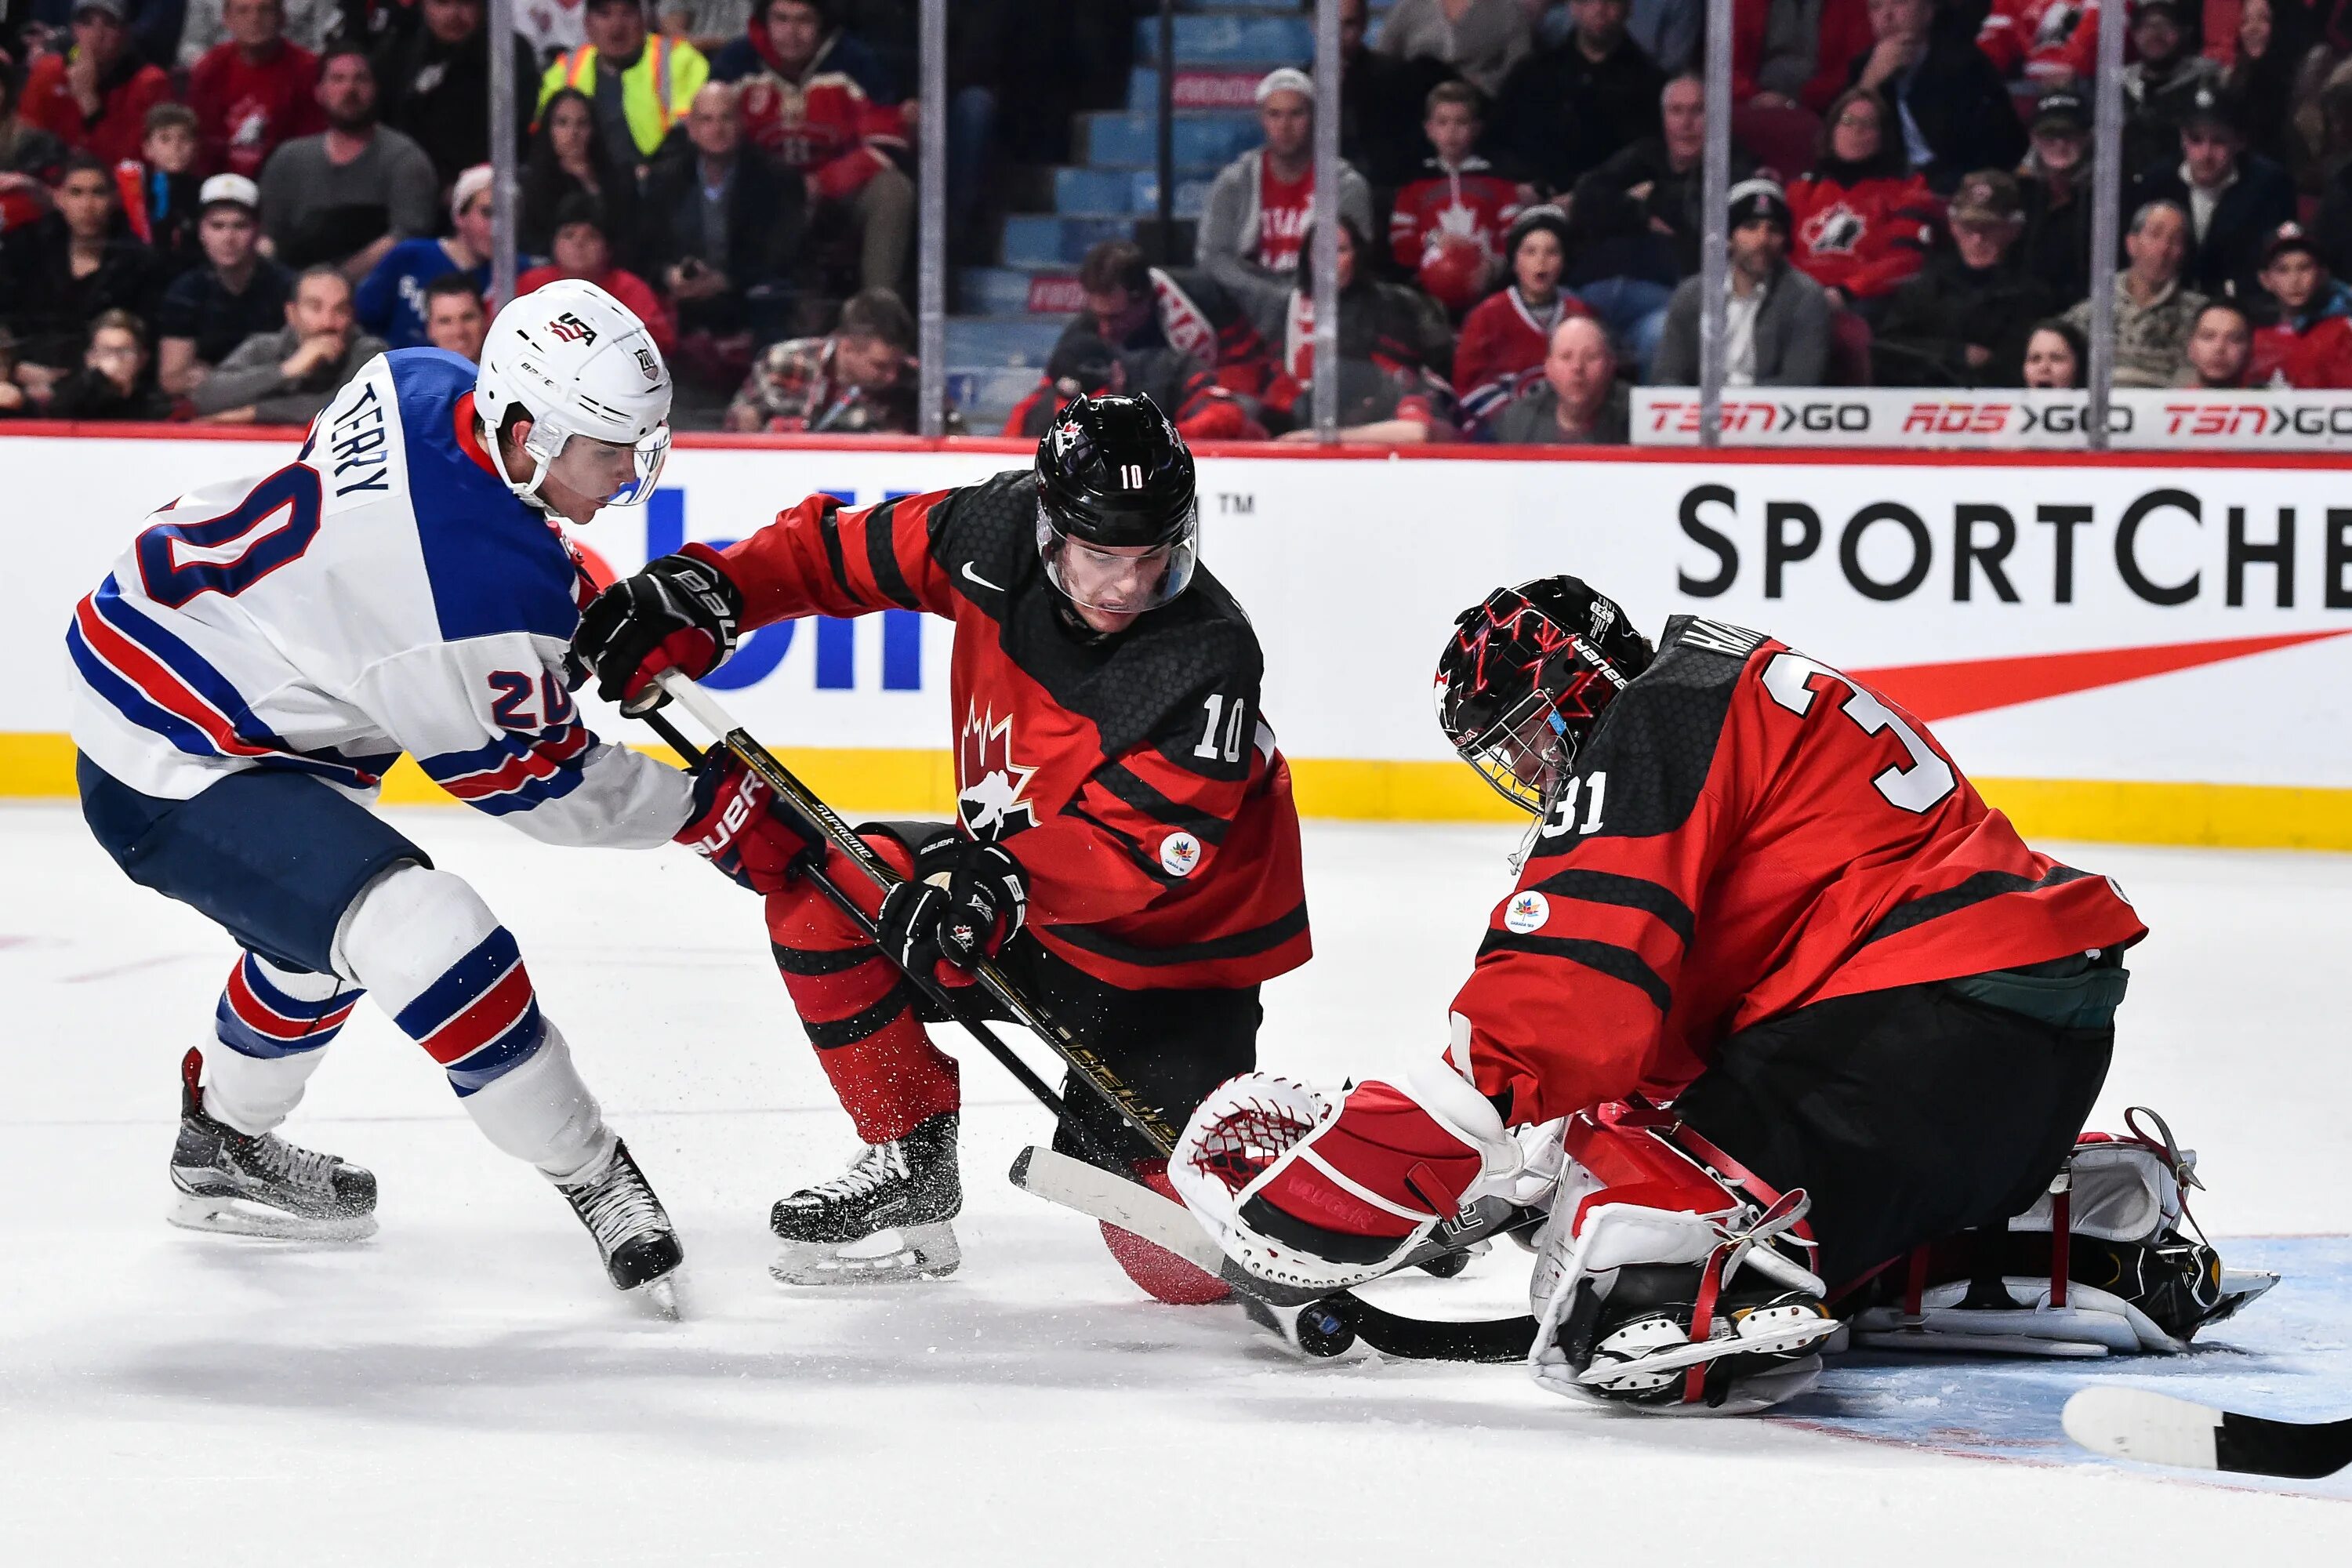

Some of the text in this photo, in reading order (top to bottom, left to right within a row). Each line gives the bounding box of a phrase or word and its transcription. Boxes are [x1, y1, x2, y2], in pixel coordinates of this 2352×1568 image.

[544, 311, 598, 347] USA
[637, 350, 657, 371] 20
[331, 382, 389, 498] TERRY
[1120, 464, 1143, 490] 10
[1219, 494, 1254, 514] TM
[487, 670, 572, 729] 20
[1193, 693, 1244, 763] 10
[1761, 652, 1959, 815] 3
[812, 804, 874, 859] SUPREME
[1541, 771, 1606, 839] 31
[920, 837, 955, 855] BAUER
